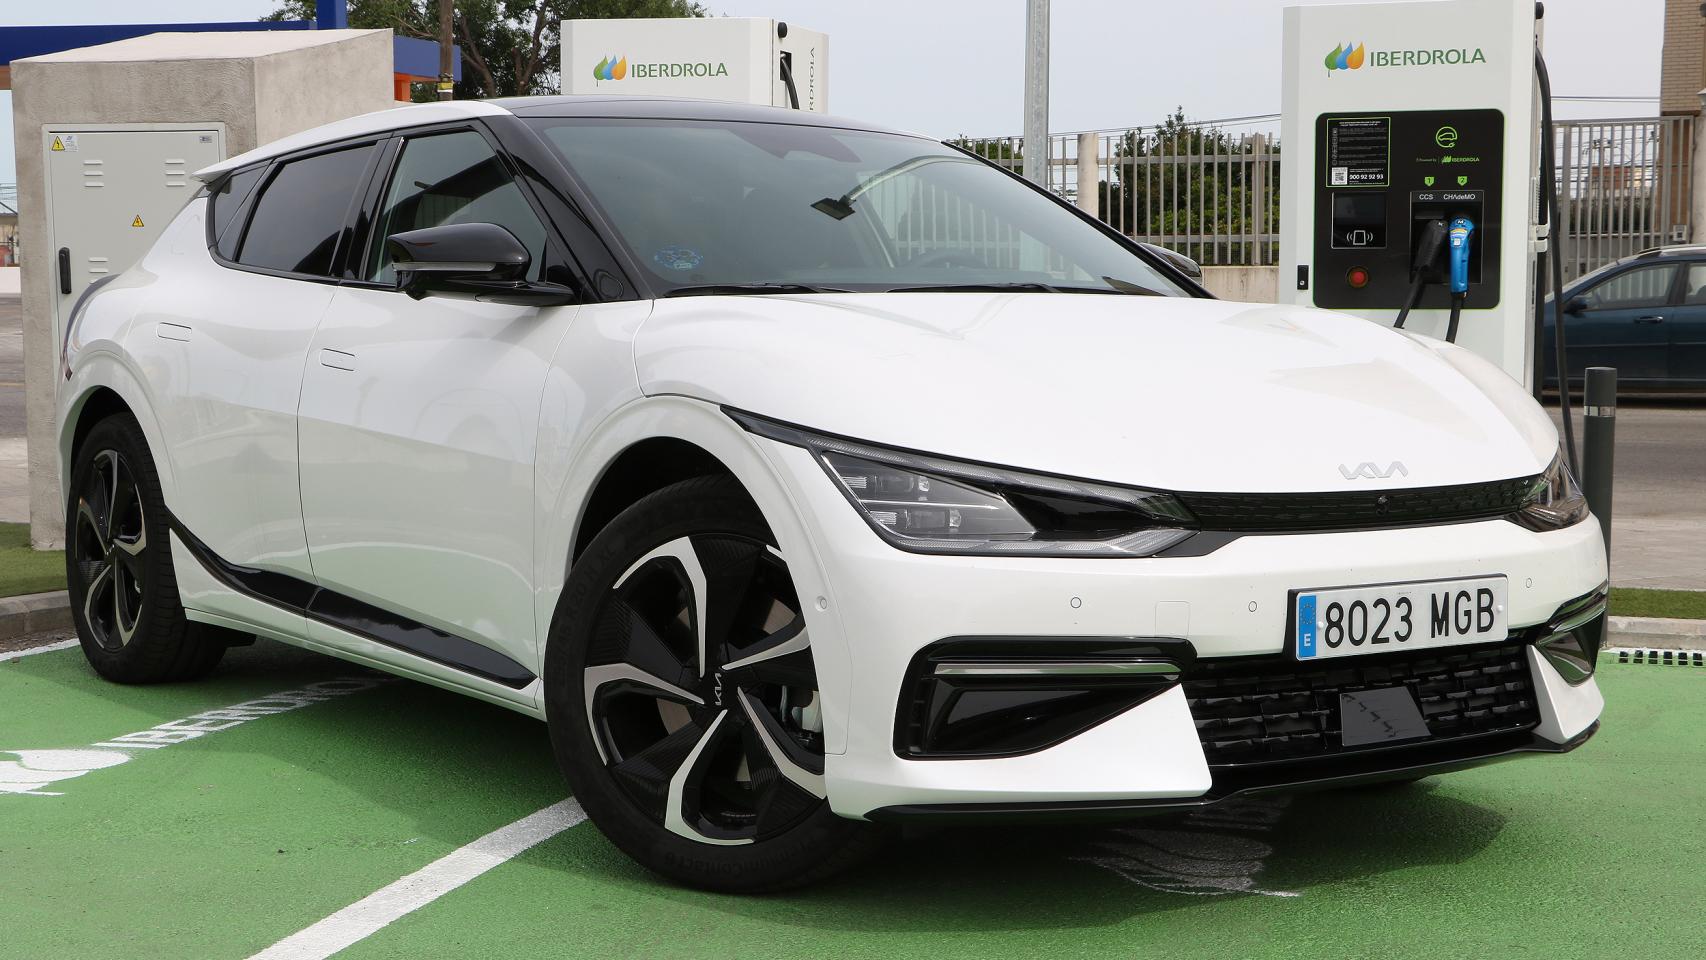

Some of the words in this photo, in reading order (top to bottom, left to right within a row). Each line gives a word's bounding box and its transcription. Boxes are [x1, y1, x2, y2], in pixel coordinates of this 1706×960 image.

[1370, 48, 1486, 67] IBERDROLA
[631, 62, 728, 78] IBERDROLA
[1337, 461, 1408, 480] KIA
[1324, 596, 1413, 648] 8023
[1430, 587, 1495, 639] MGB
[1304, 632, 1311, 647] E
